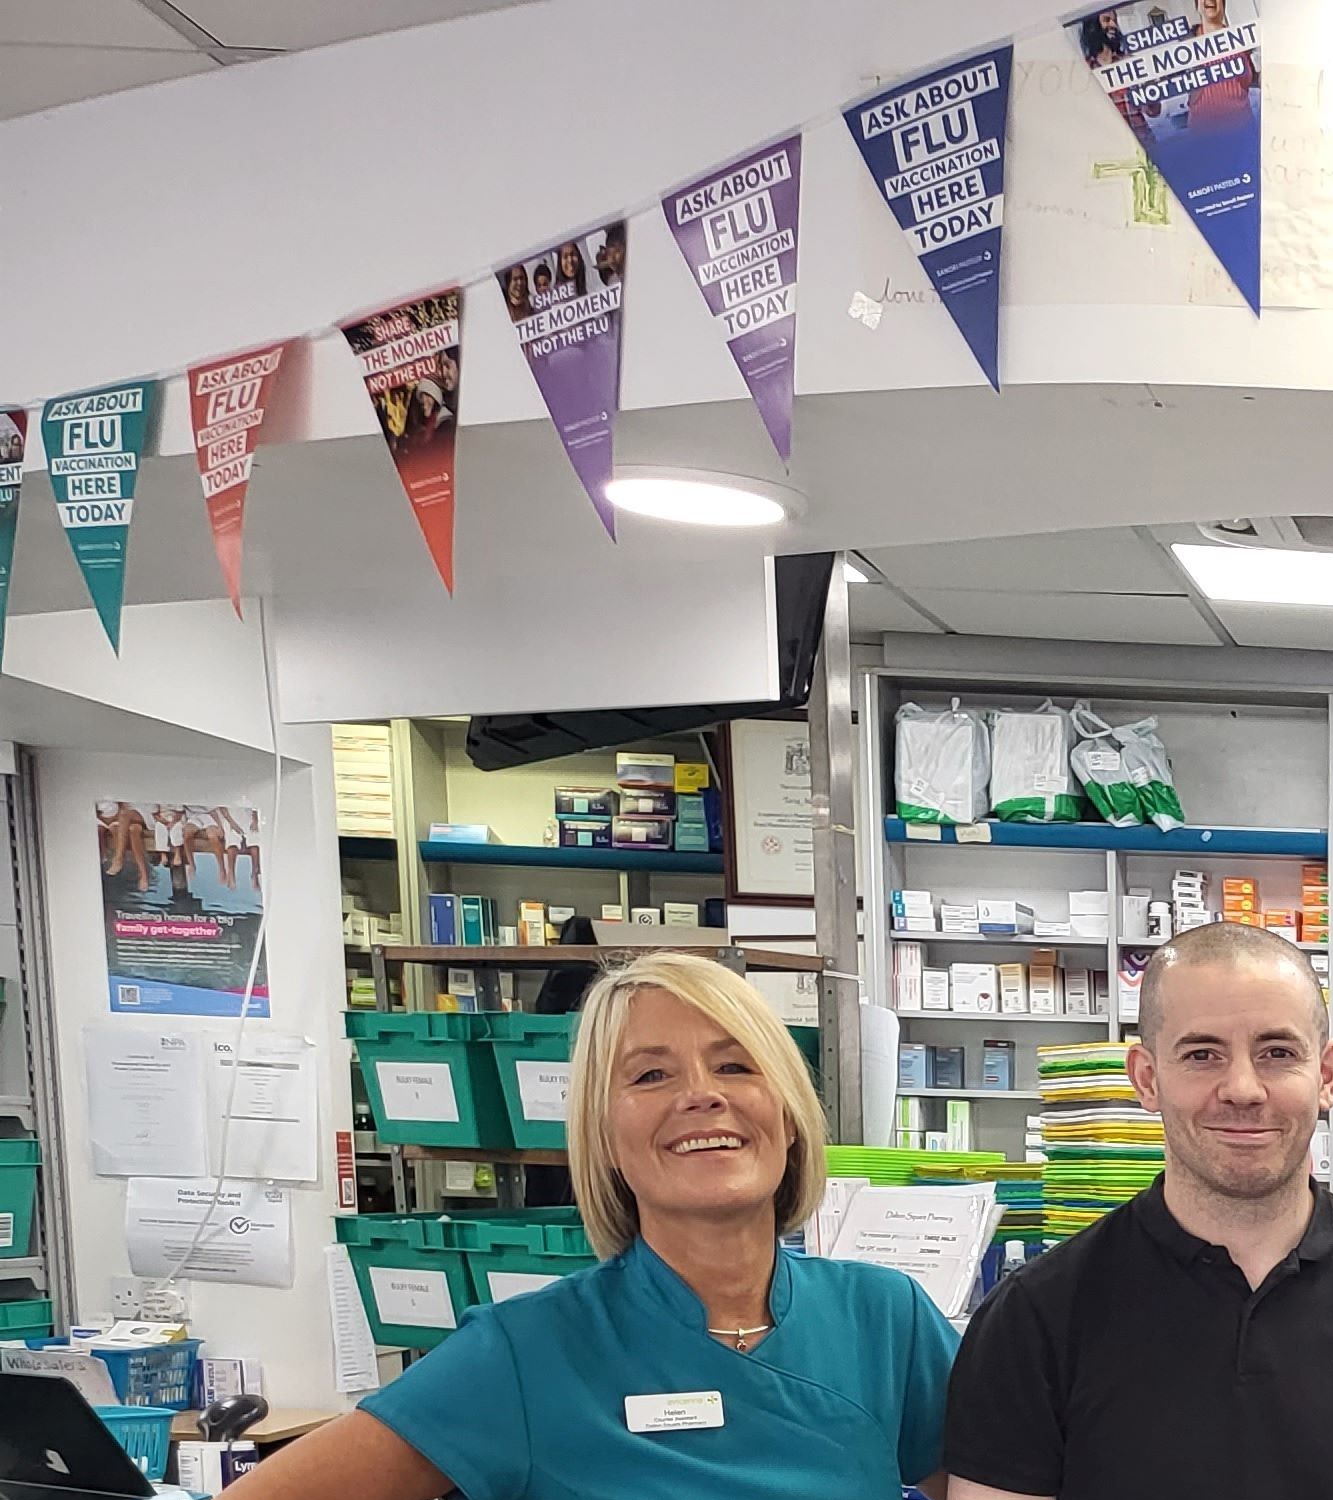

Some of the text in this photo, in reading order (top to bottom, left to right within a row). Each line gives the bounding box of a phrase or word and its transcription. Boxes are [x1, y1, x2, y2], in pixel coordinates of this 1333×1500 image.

[1126, 19, 1188, 50] SHARE
[1101, 23, 1257, 88] THE MOMENT
[867, 65, 993, 134] ASK ABOUT
[1131, 57, 1245, 106] NOT THE FLU
[901, 107, 969, 163] FLU
[889, 144, 995, 193] VACCINATION
[681, 155, 785, 220] ASK ABOUT
[917, 175, 980, 215] HERE
[709, 197, 768, 251] FLU
[914, 202, 994, 249] TODAY
[702, 233, 790, 279] VACCINATION
[534, 284, 575, 308] SHARE
[725, 264, 777, 301] HERE
[375, 319, 411, 342] SHARE
[517, 287, 620, 340] THE MOMENT
[724, 291, 789, 334] TODAY
[364, 327, 453, 371] THE MOMENT
[532, 317, 609, 357] NOT THE FLU
[201, 353, 280, 390] ASK ABOUT
[370, 358, 438, 392] NOT THE FLU
[51, 391, 140, 418] ASK ABOUT
[211, 382, 256, 419] FLU
[68, 420, 116, 450] FLU
[201, 413, 260, 441] VACCINATION
[54, 456, 132, 472] VACCINATION
[211, 437, 244, 461] HERE
[71, 477, 117, 496] HERE
[207, 462, 247, 492] TODAY
[65, 503, 125, 522] TODAY
[116, 911, 162, 922] Travelling
[164, 912, 191, 922] home
[194, 914, 207, 923] for
[218, 915, 234, 926] big
[116, 924, 148, 935] family
